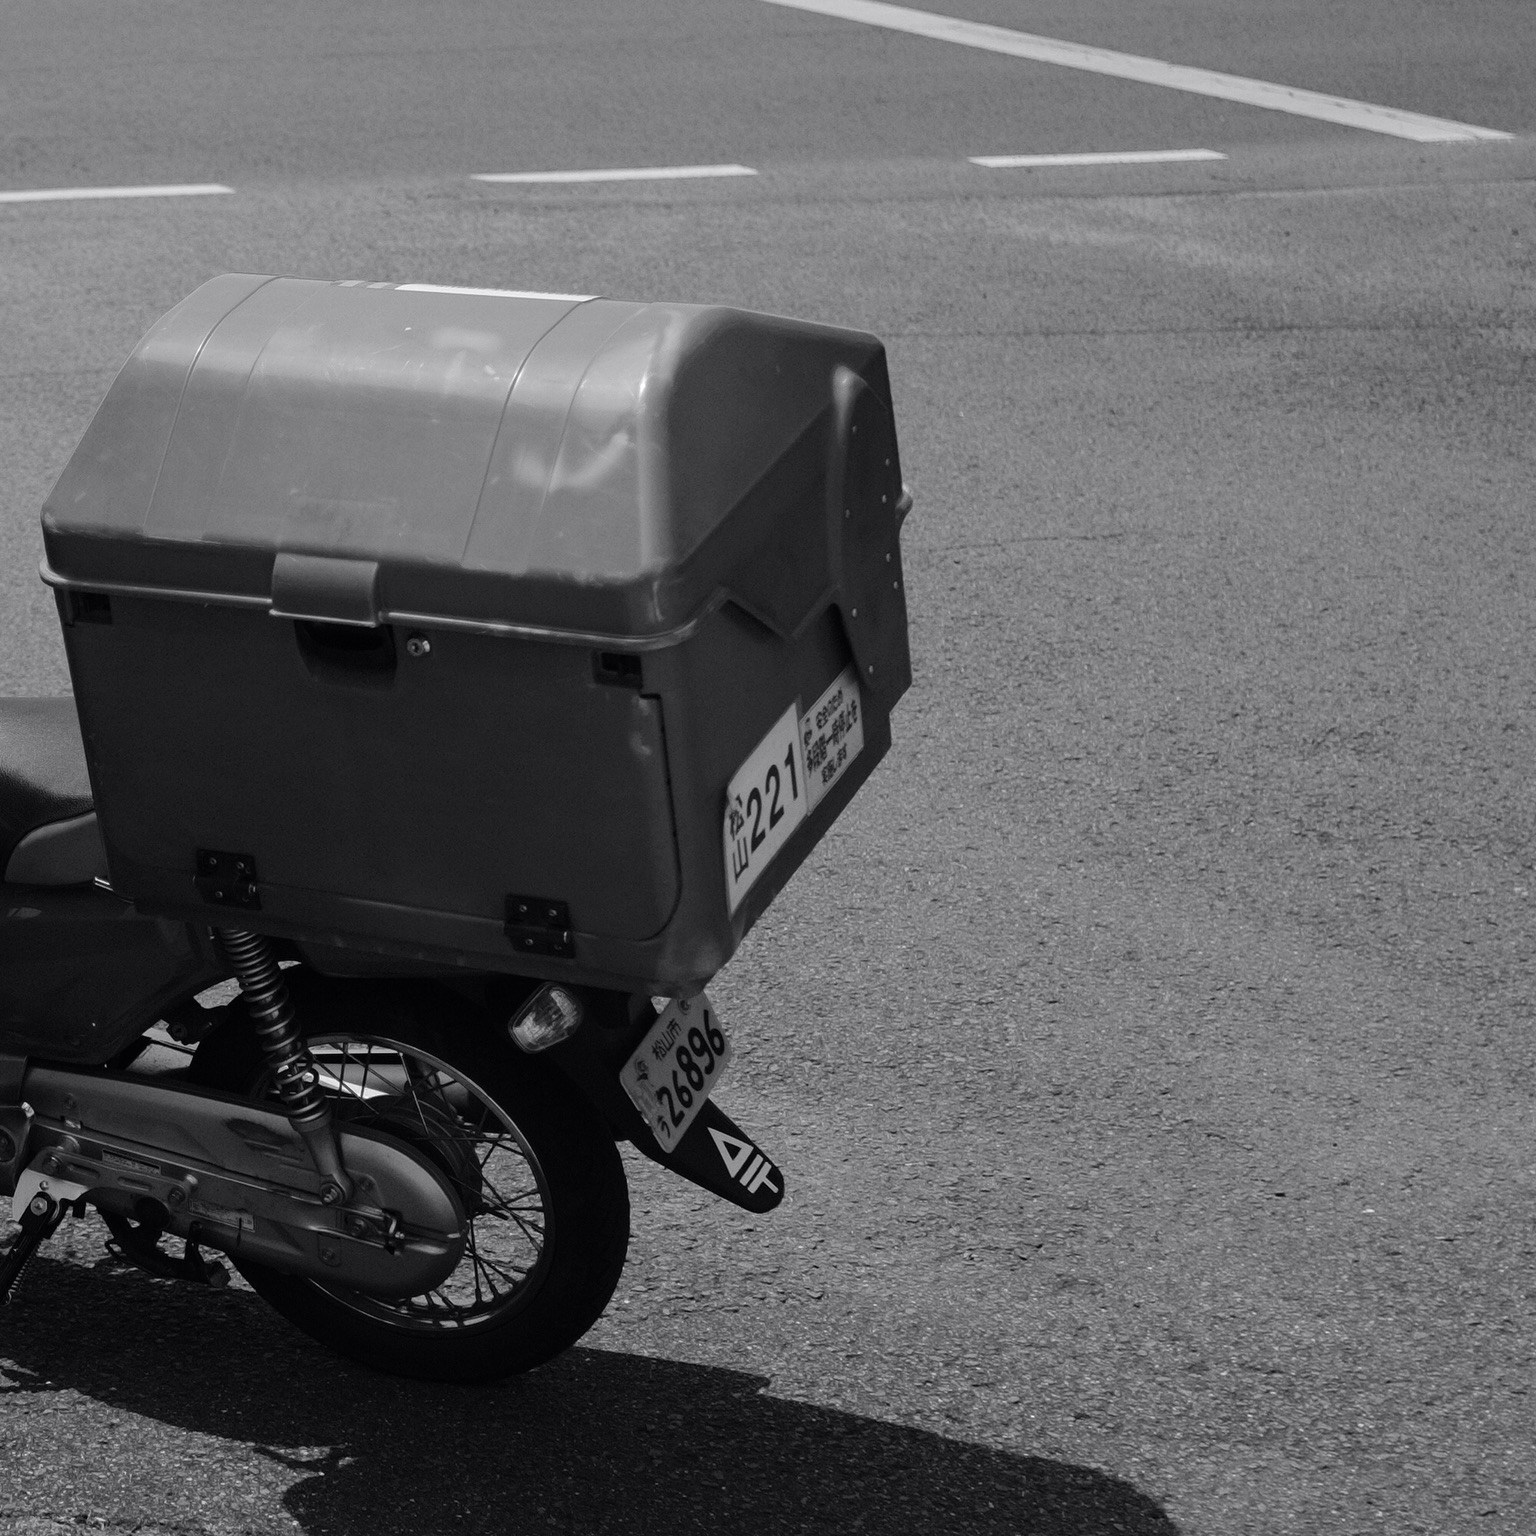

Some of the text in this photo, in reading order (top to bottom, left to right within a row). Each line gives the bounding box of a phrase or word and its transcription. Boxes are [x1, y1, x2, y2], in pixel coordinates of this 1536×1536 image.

[728, 741, 800, 884] 松山 221
[651, 1017, 682, 1062] 松山市
[655, 1009, 726, 1128] 26896
